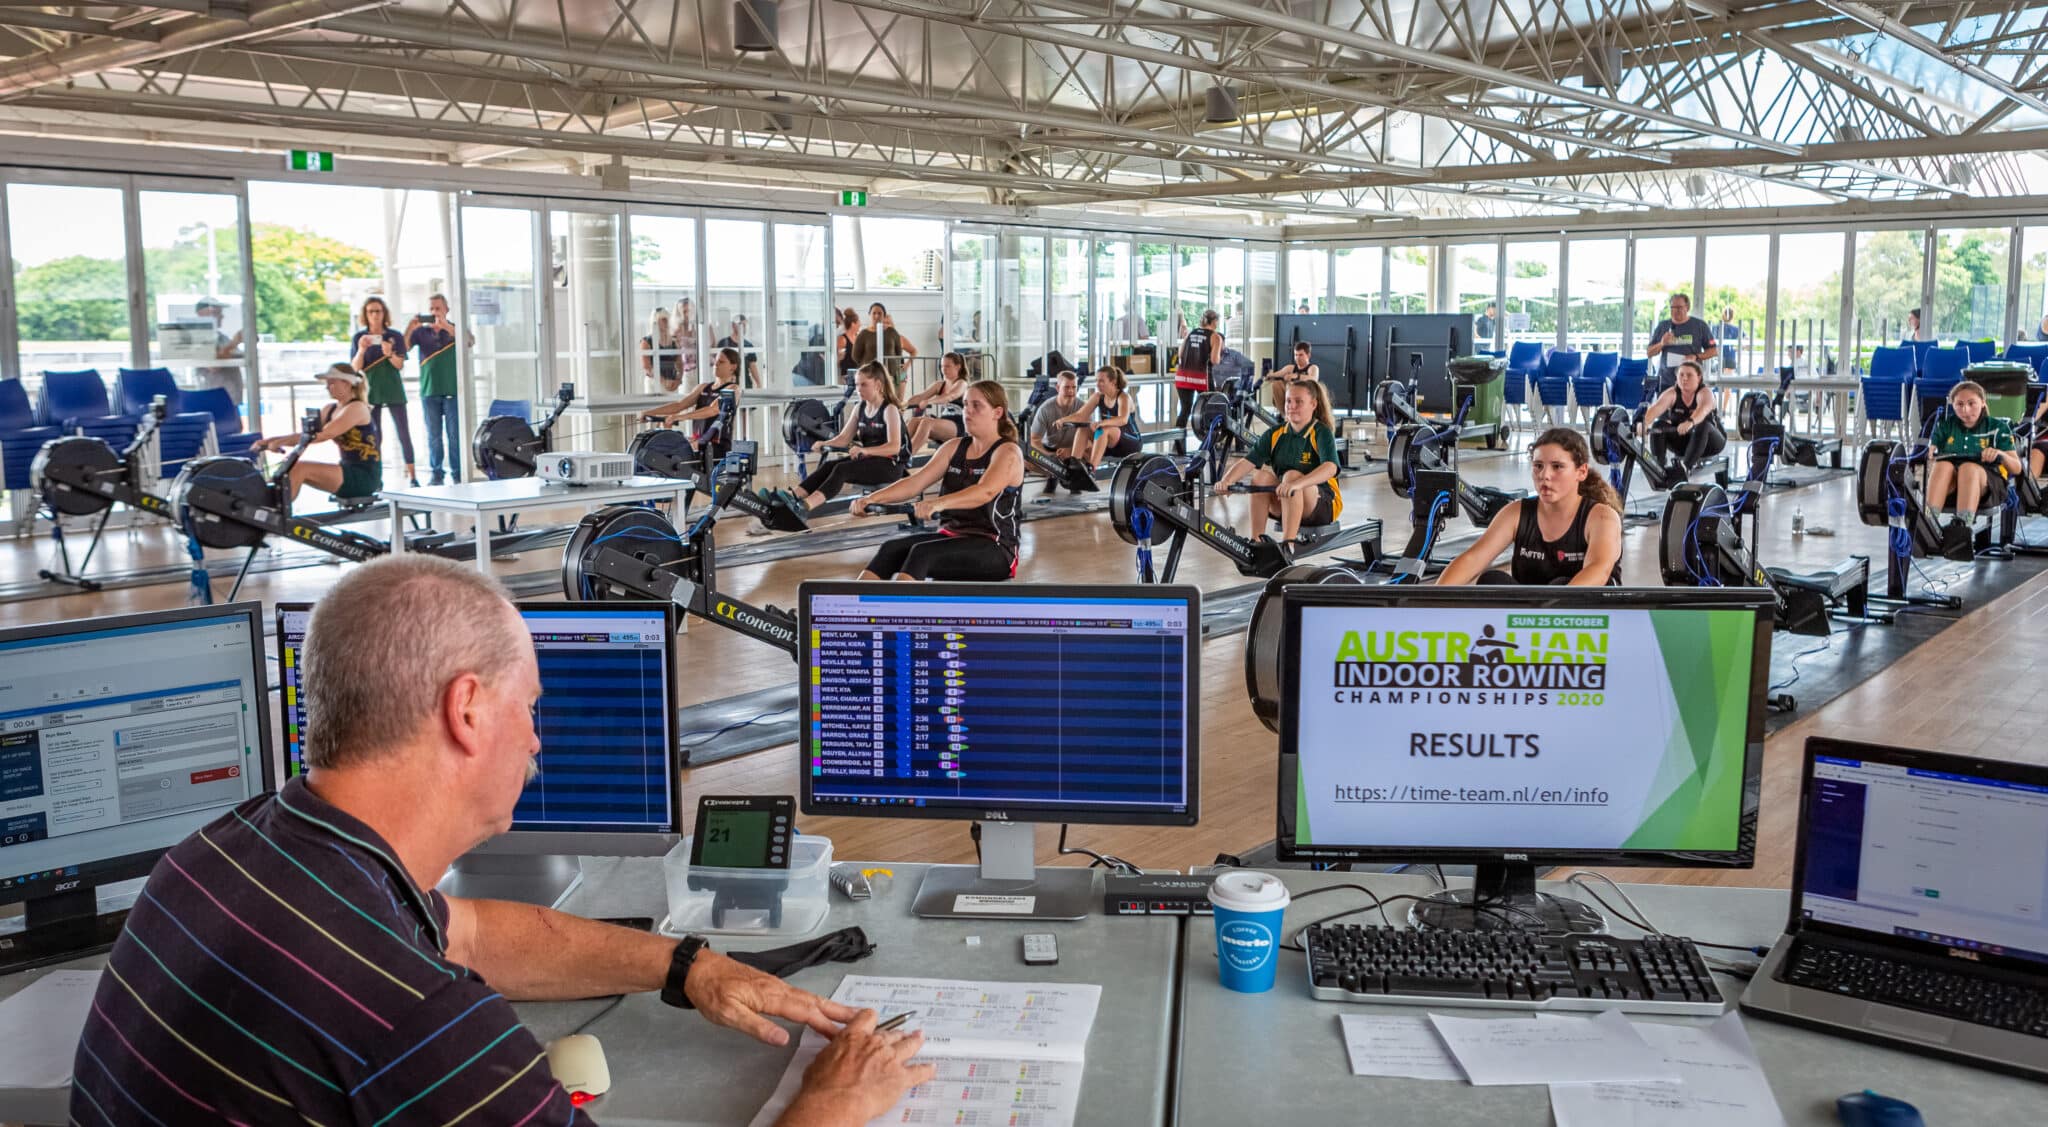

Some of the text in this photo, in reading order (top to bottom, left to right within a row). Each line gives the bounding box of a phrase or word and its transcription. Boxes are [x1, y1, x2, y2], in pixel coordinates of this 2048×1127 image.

[734, 494, 761, 510] ncept
[312, 533, 364, 557] concept
[1215, 531, 1245, 554] concept
[737, 611, 793, 642] concept
[1512, 617, 1605, 627] SUN 25 OCTOBER
[1335, 630, 1609, 664] AUSTRLIAN
[1338, 663, 1602, 688] INDOOR ROWING
[1334, 690, 1605, 706] CHAMPIONSHIPS 2020
[1409, 733, 1540, 758] RESULTS
[1334, 784, 1609, 804] https://time-team.nl/en/info
[985, 811, 1008, 819] DELL
[709, 828, 730, 843] 21
[55, 880, 80, 891] acer
